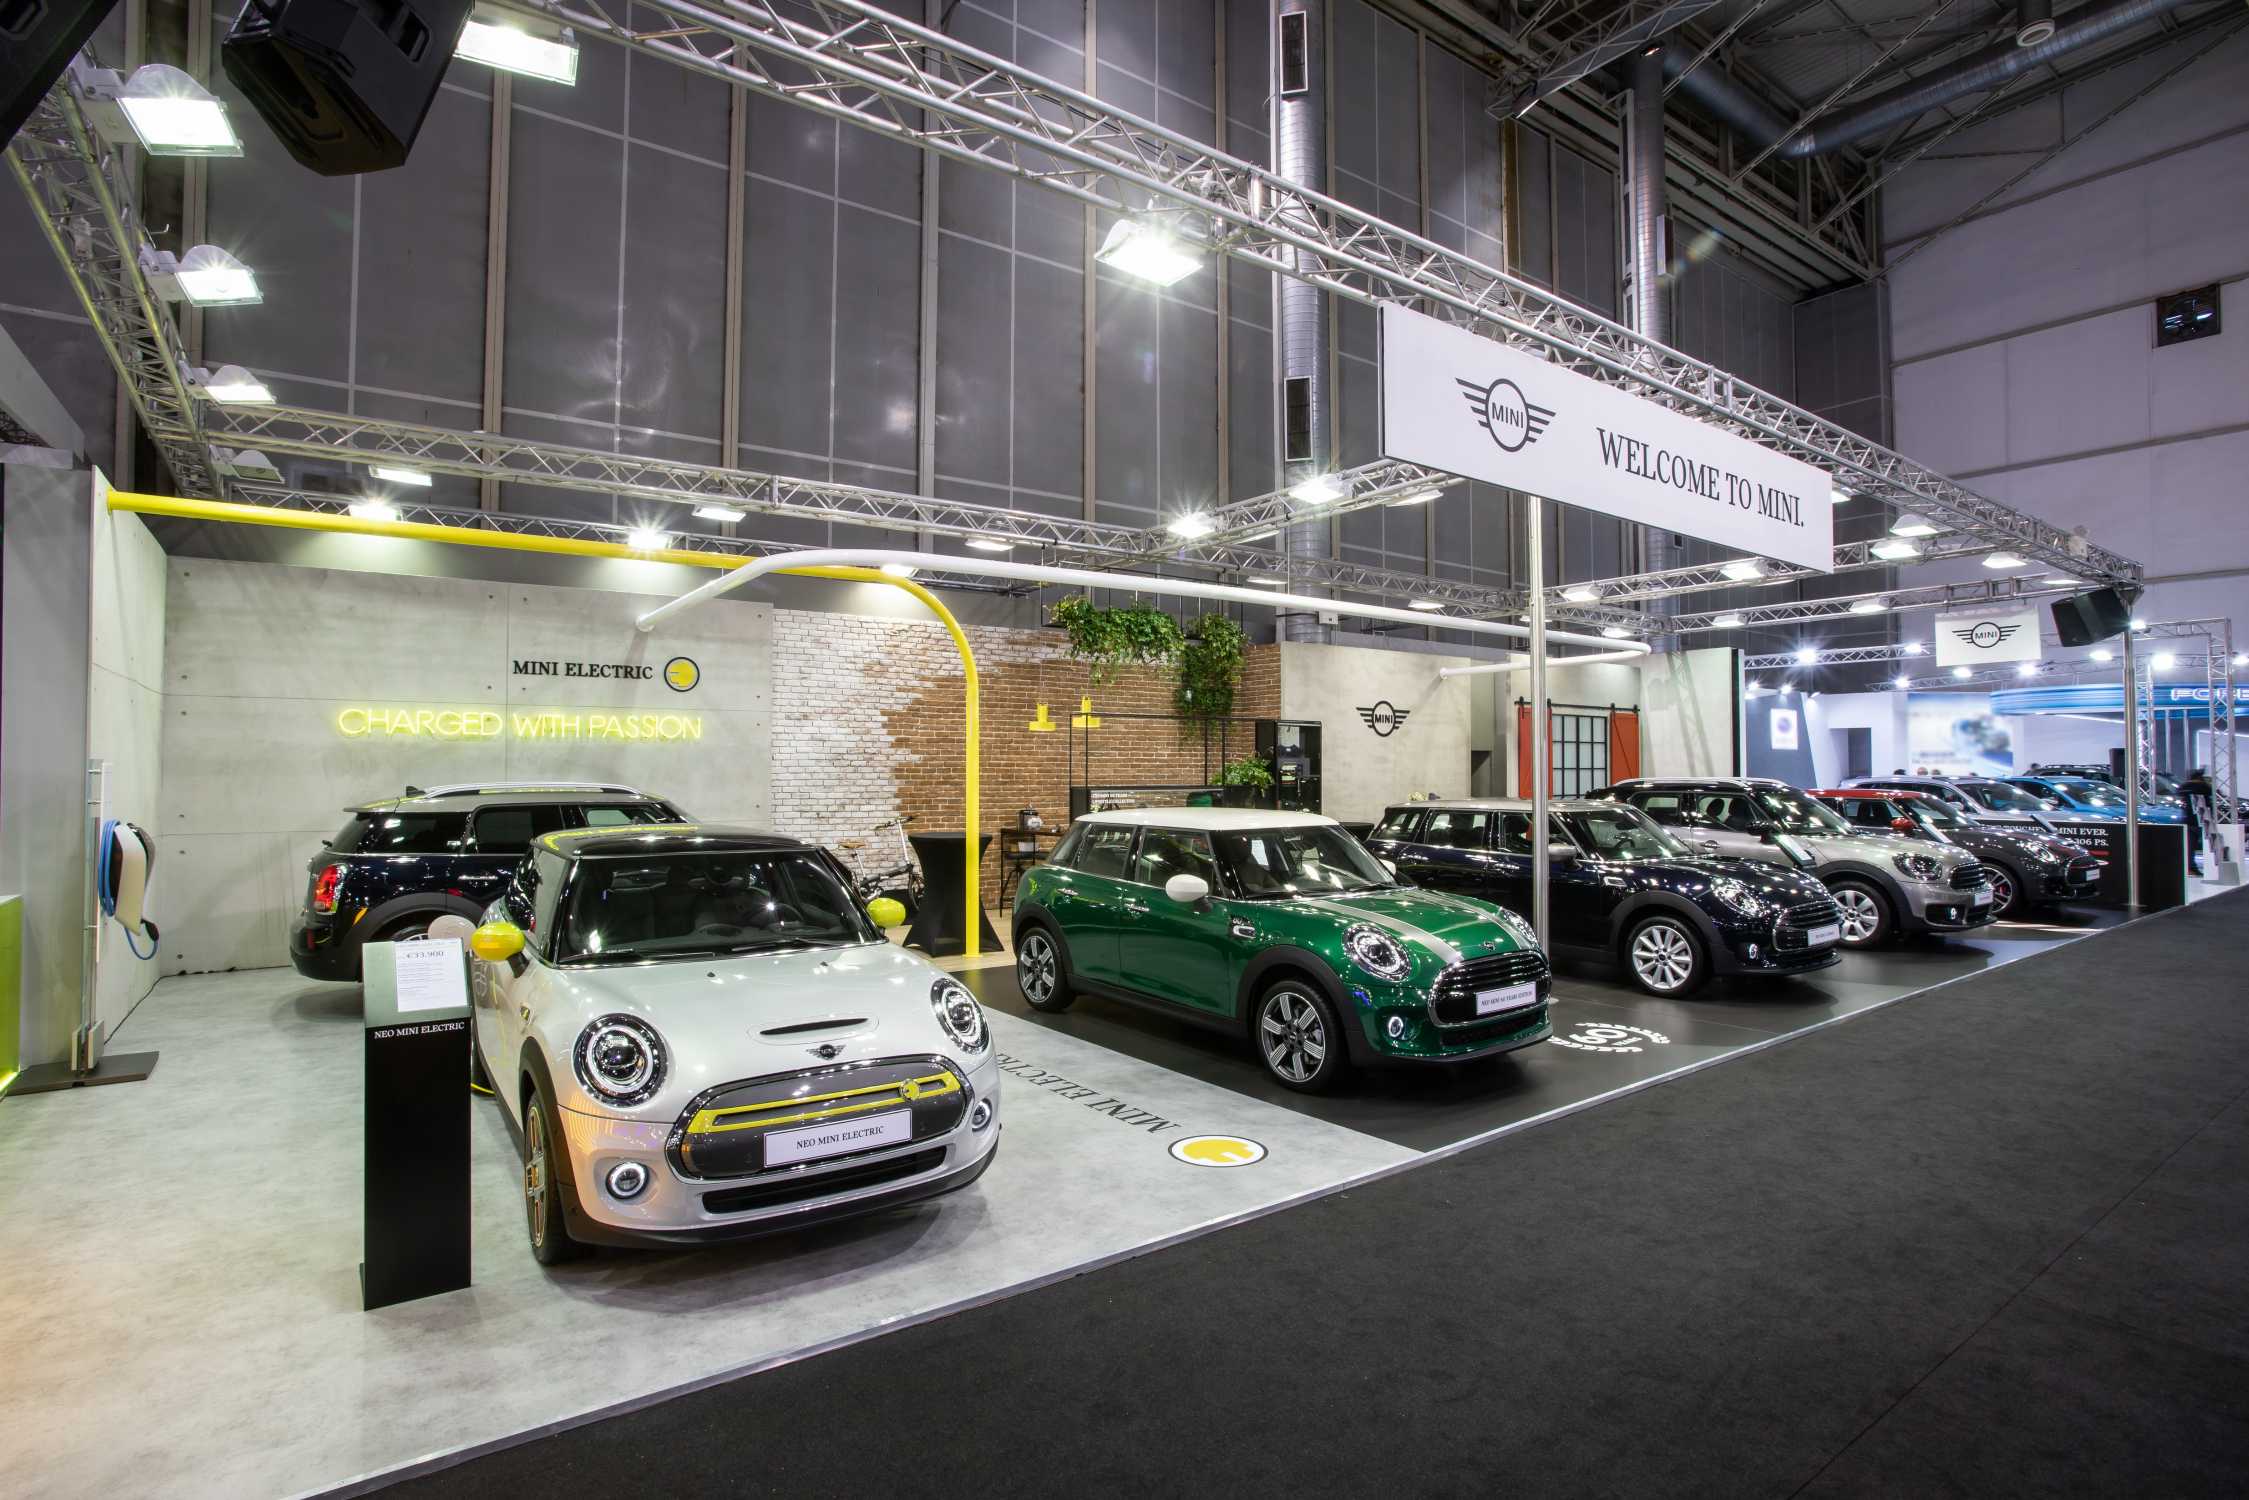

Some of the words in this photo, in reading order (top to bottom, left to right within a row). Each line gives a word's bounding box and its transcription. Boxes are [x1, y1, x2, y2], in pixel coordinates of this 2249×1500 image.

[1491, 402, 1524, 429] MINI
[1596, 427, 1720, 501] WELCOME
[1725, 472, 1752, 510] TO
[1757, 483, 1804, 528] MINI.
[1974, 630, 1998, 640] MINI
[513, 660, 559, 676] MINI
[565, 662, 653, 679] ELECTRIC
[338, 708, 504, 736] CHARGED
[512, 712, 581, 738] WITH
[588, 714, 702, 740] PASSION
[1374, 714, 1393, 724] MINI
[2079, 828, 2109, 836] EVER.
[2094, 838, 2109, 846] PS.
[374, 1029, 395, 1040] NEO
[396, 1026, 419, 1037] MINI
[421, 1021, 465, 1034] ELECTRIC
[997, 1053, 1102, 1100] ELECTR
[1084, 1097, 1181, 1133] MINI
[796, 1138, 816, 1150] NEO
[818, 1133, 840, 1146] MINI
[842, 1125, 885, 1141] ELECTRIC
